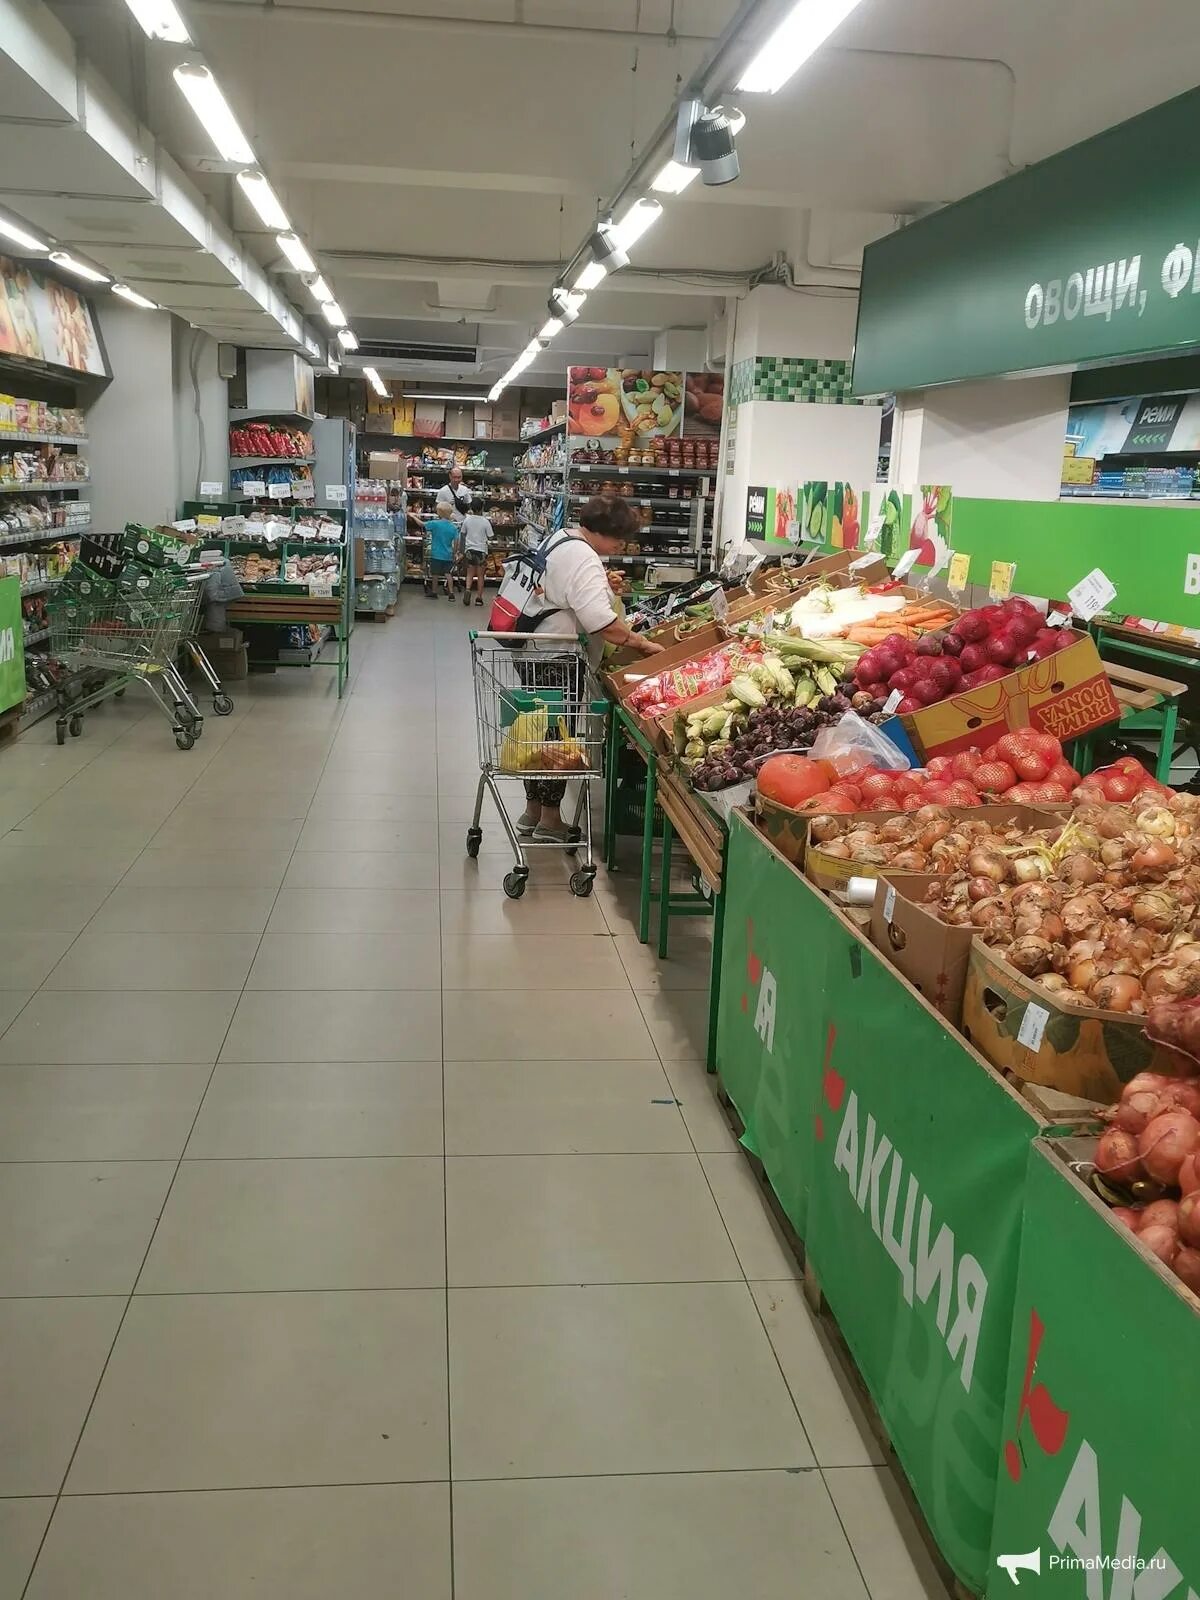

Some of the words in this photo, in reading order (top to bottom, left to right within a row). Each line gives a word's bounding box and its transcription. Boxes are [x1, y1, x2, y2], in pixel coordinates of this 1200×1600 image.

[1024, 254, 1148, 330] ОВОЩИ,
[1160, 239, 1200, 299] Ф
[1038, 679, 1110, 724] DONNA
[1044, 698, 1115, 739] PRIMA
[833, 1090, 989, 1394] АКЦИЯ
